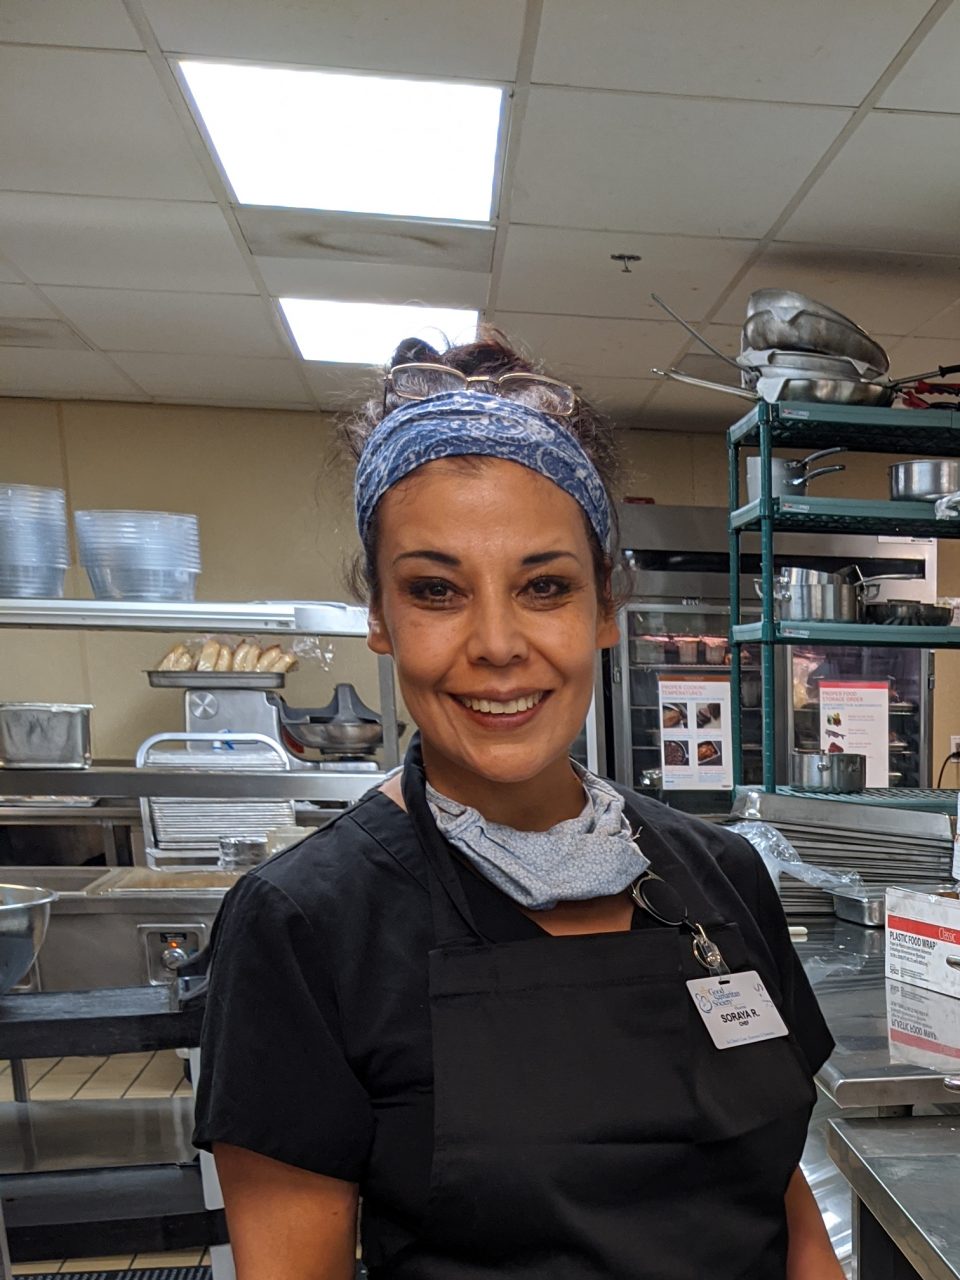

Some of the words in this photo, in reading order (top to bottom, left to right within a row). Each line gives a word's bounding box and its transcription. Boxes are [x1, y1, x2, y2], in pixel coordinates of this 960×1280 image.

[889, 931, 908, 944] PLASTIC
[908, 935, 922, 947] FOOD
[938, 927, 957, 943] Classic
[720, 1011, 751, 1023] SORAYA
